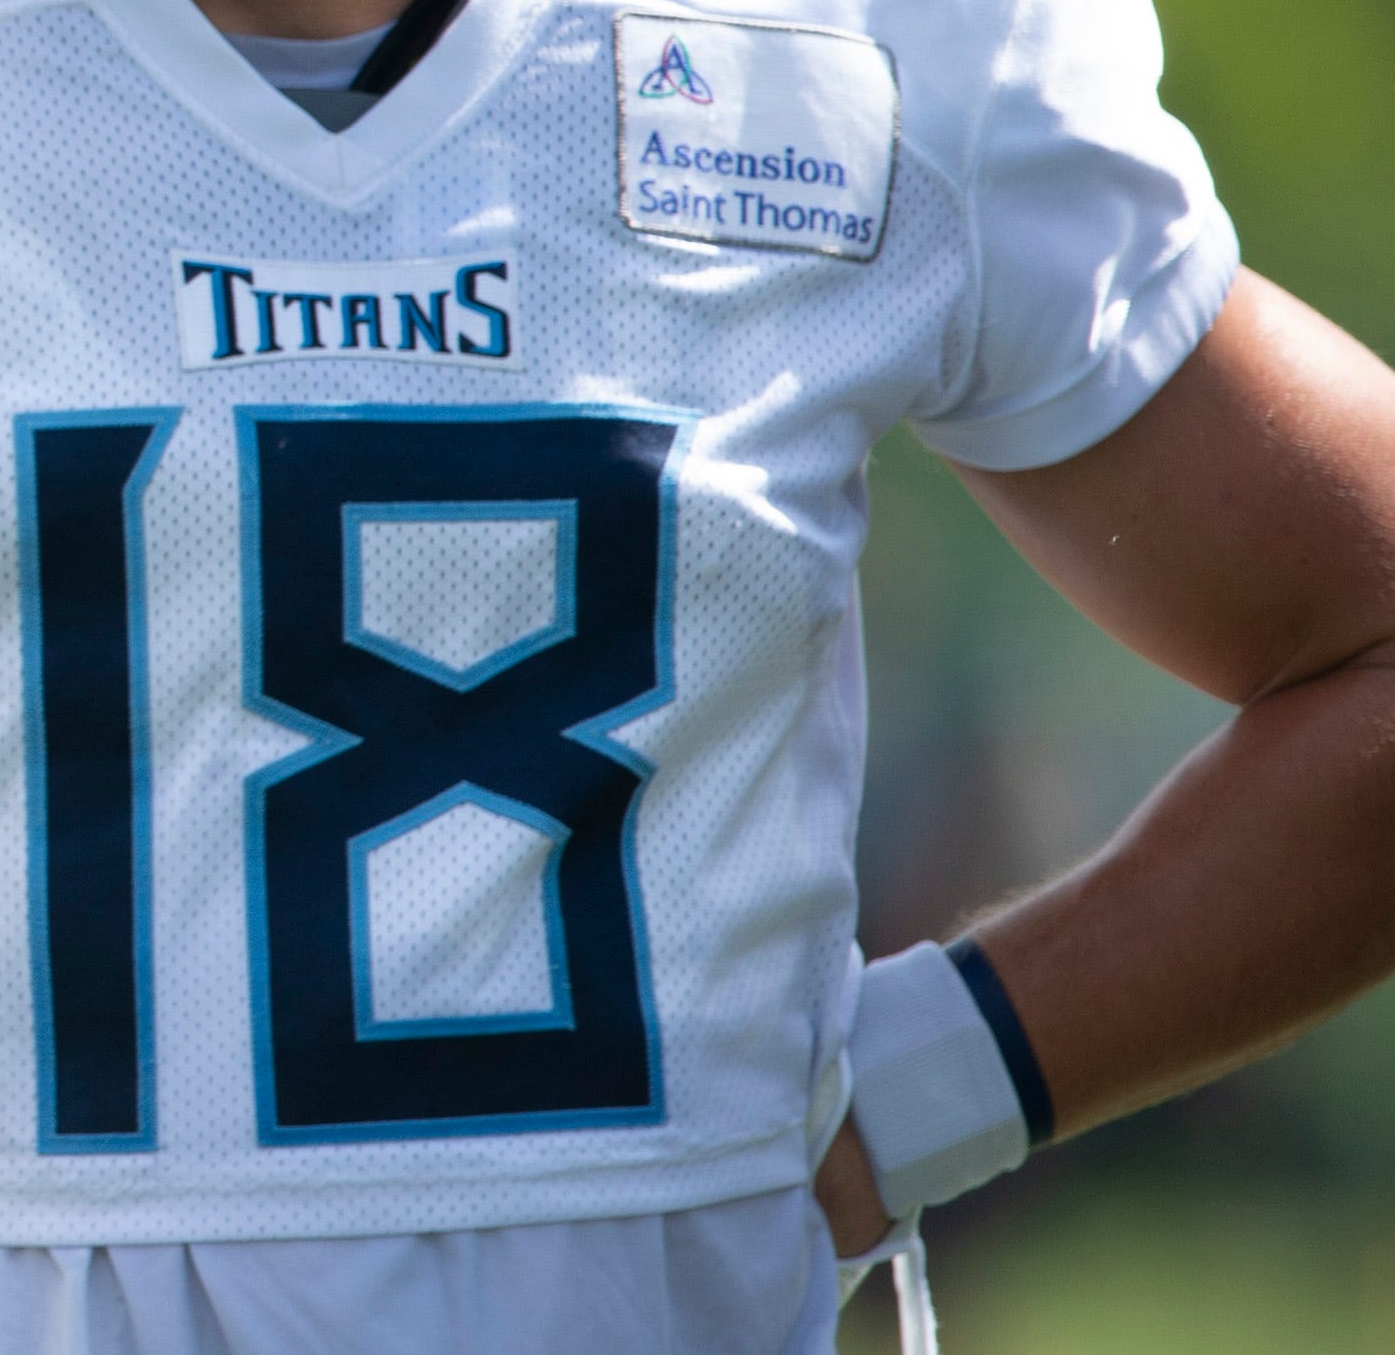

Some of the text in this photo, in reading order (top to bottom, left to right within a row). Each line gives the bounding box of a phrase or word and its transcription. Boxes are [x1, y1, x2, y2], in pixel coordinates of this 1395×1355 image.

[640, 131, 847, 189] Ascension
[639, 180, 874, 244] Saint Thomas
[181, 260, 511, 359] TITANS
[11, 401, 704, 1155] 18
